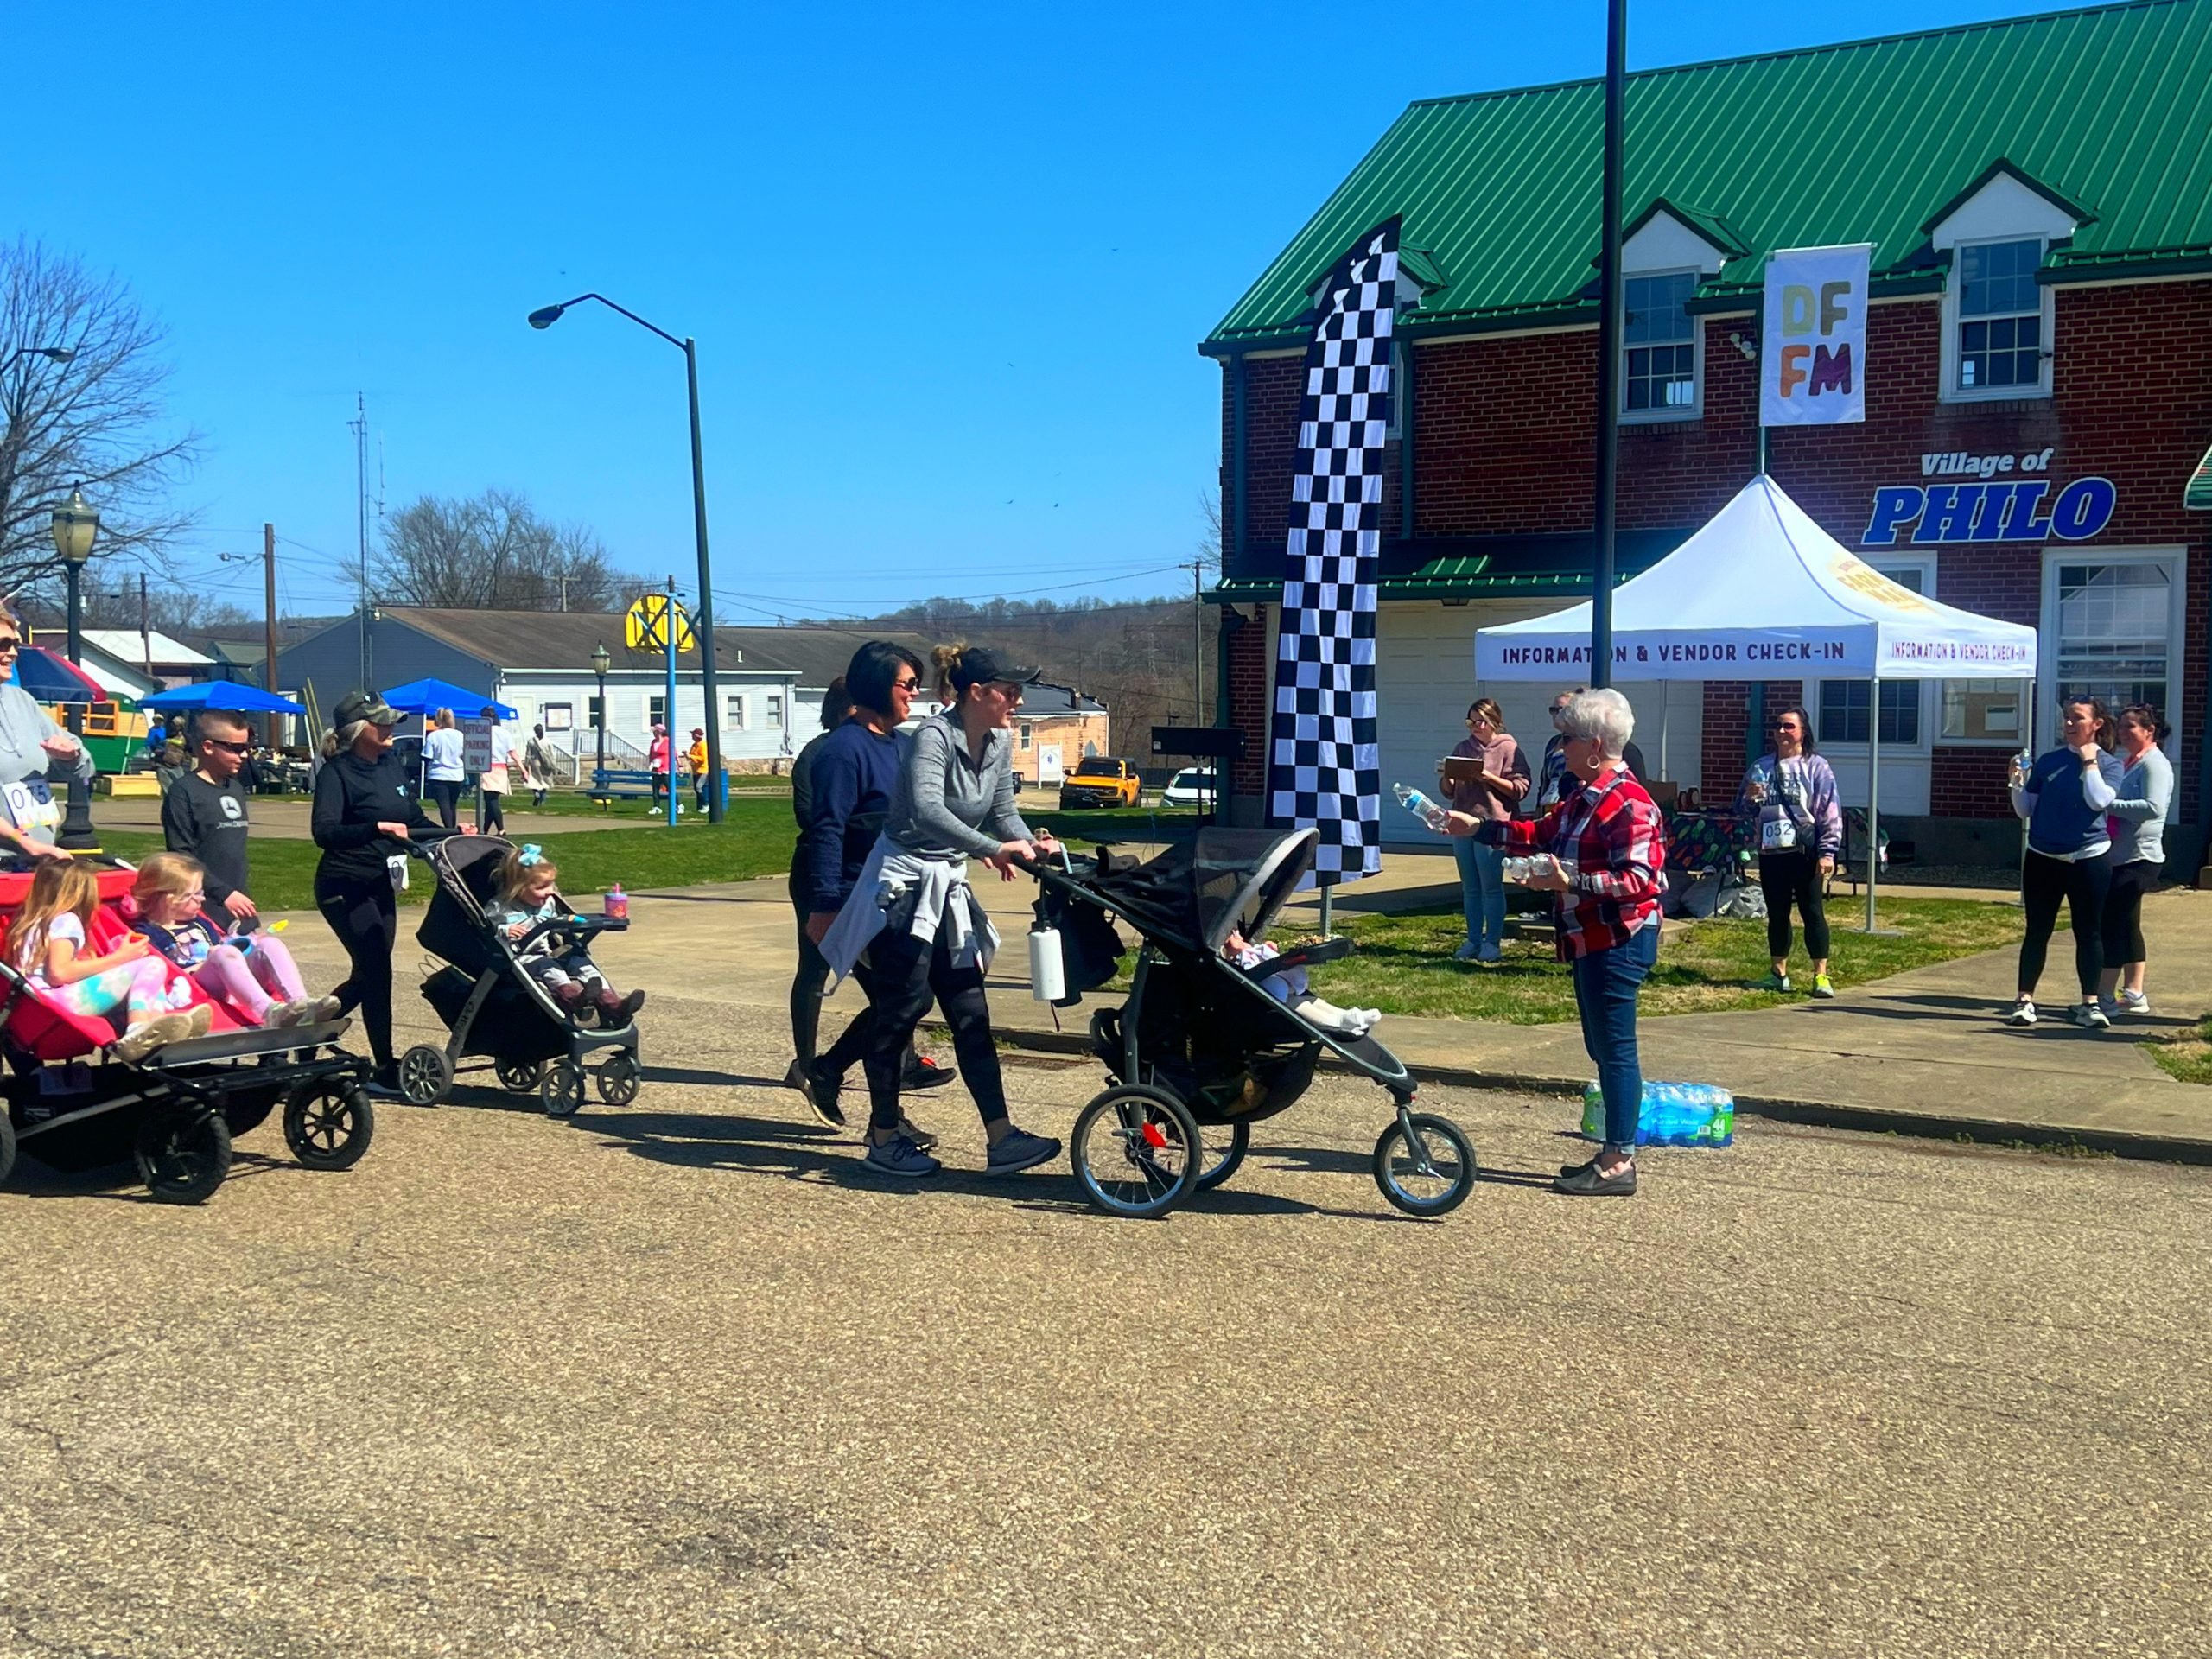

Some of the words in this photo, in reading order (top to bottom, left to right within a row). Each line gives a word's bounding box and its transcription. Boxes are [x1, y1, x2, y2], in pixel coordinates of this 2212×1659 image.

[1783, 280, 1852, 338] DF
[1780, 342, 1853, 398] FM
[1921, 452, 2013, 478] Village
[2020, 448, 2054, 472] of
[1860, 476, 2117, 545] PHILO
[1503, 645, 1627, 664] INFORMATN
[1637, 645, 1649, 662] &
[1658, 644, 1737, 662] VENDOR
[1746, 642, 1844, 660] CHECK-IN
[1891, 641, 1948, 659] INFORMATION
[1958, 643, 1990, 660] VENDOR
[1992, 645, 2026, 661] CHECK-IN
[1765, 823, 1792, 838] 052
